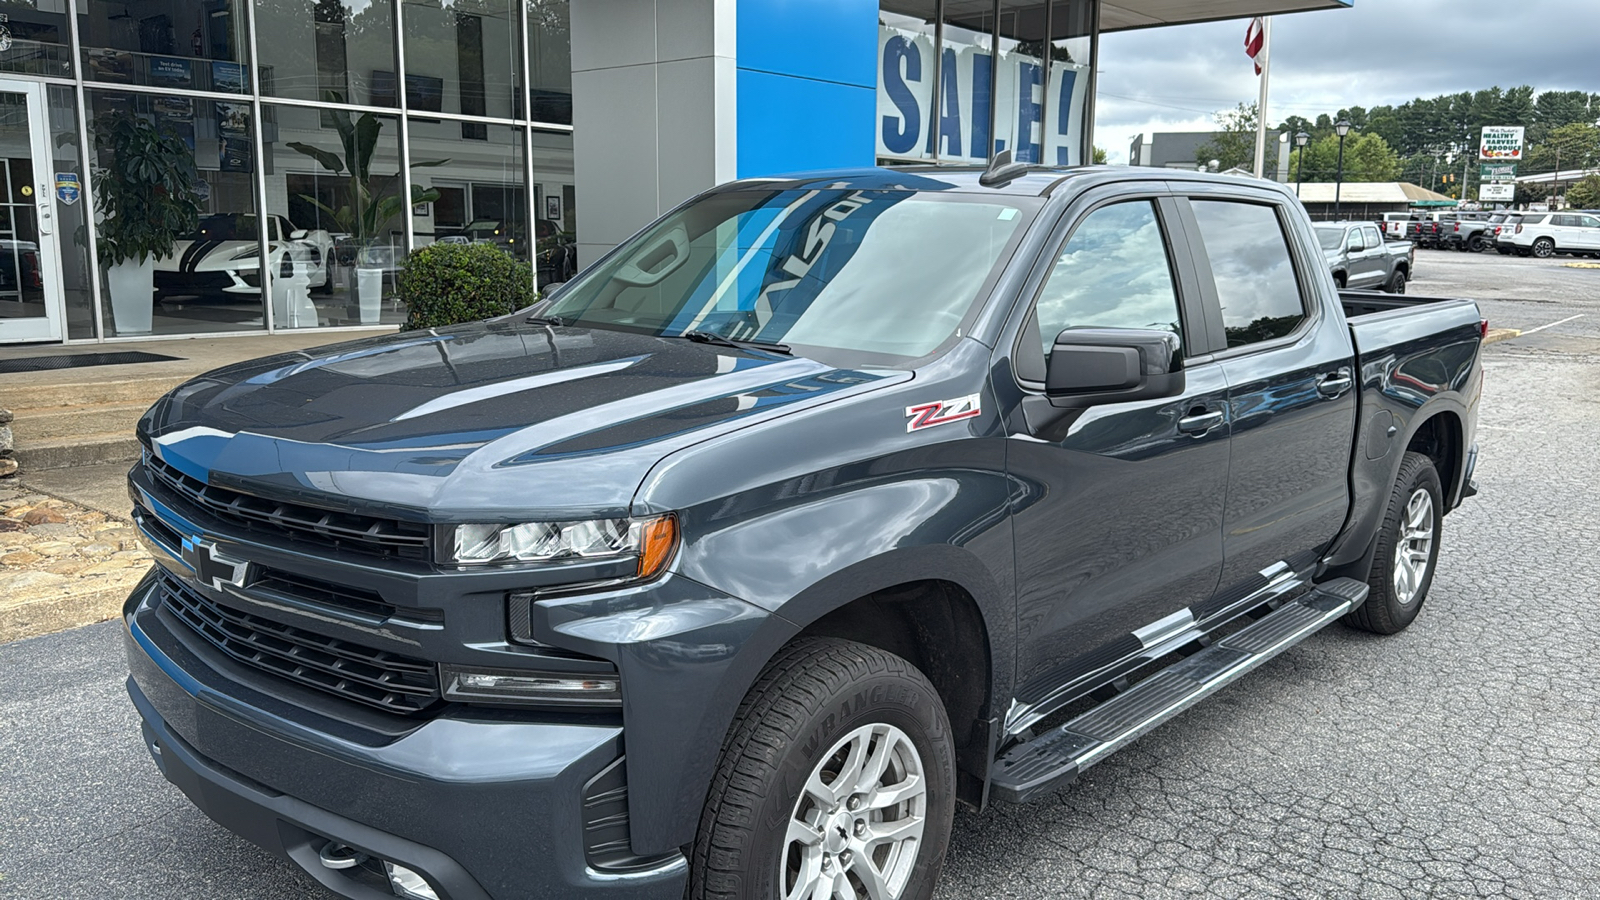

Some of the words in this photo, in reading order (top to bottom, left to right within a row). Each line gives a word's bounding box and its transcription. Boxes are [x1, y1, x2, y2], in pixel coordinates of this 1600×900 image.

[881, 35, 1078, 165] SALE!
[905, 392, 981, 433] Z71
[801, 683, 921, 760] WRANGLER
